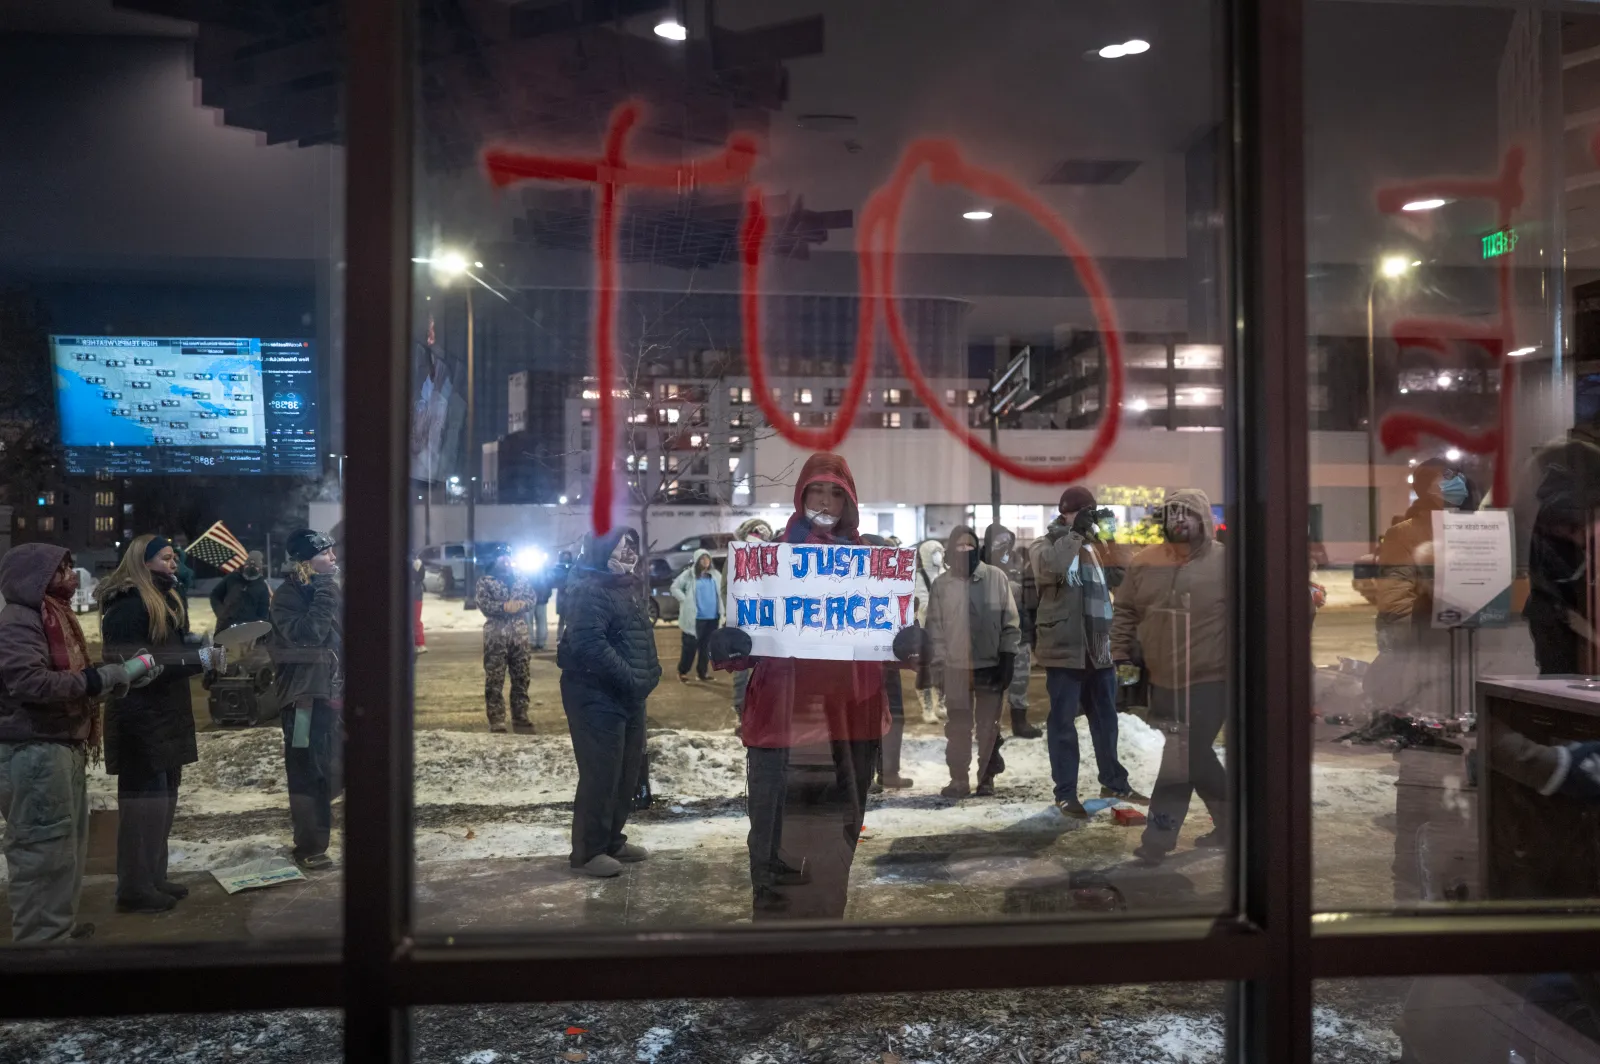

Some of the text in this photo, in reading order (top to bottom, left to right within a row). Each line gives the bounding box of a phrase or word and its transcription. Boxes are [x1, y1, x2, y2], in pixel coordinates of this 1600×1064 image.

[733, 544, 915, 582] NO JUSTICE
[734, 595, 777, 629] NO
